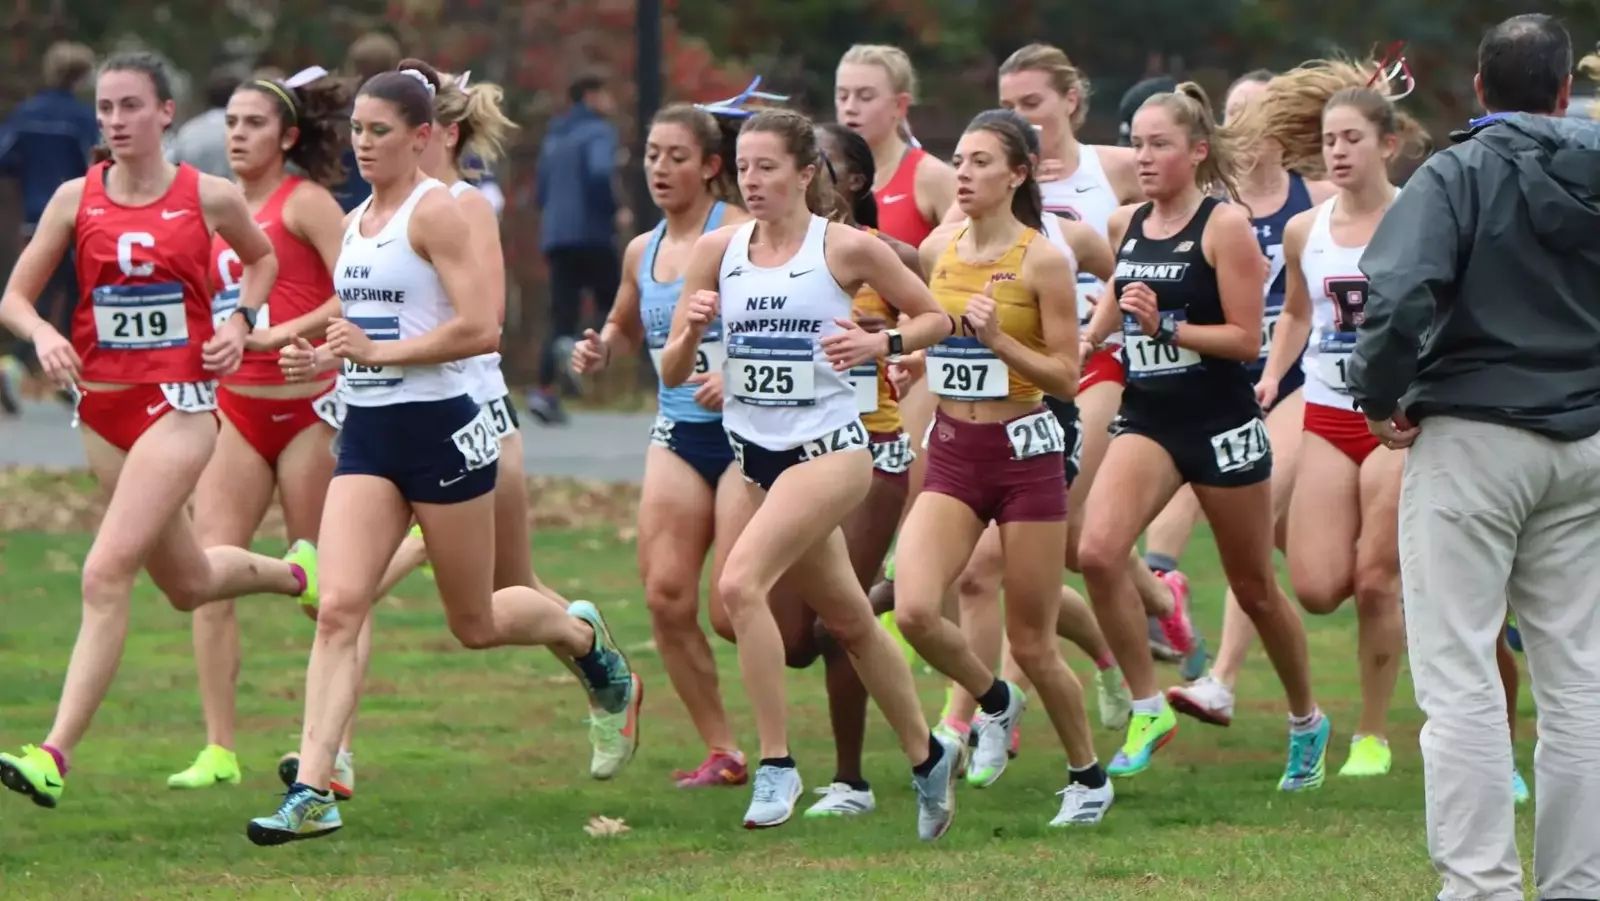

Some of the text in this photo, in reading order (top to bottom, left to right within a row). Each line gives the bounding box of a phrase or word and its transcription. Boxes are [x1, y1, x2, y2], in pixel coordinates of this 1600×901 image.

[117, 232, 155, 276] C
[344, 266, 371, 279] NEW
[746, 296, 787, 311] NEW
[112, 311, 168, 337] 219
[1136, 341, 1180, 366] 170
[744, 365, 794, 394] 325
[942, 363, 988, 391] 297
[1221, 422, 1267, 466] 170
